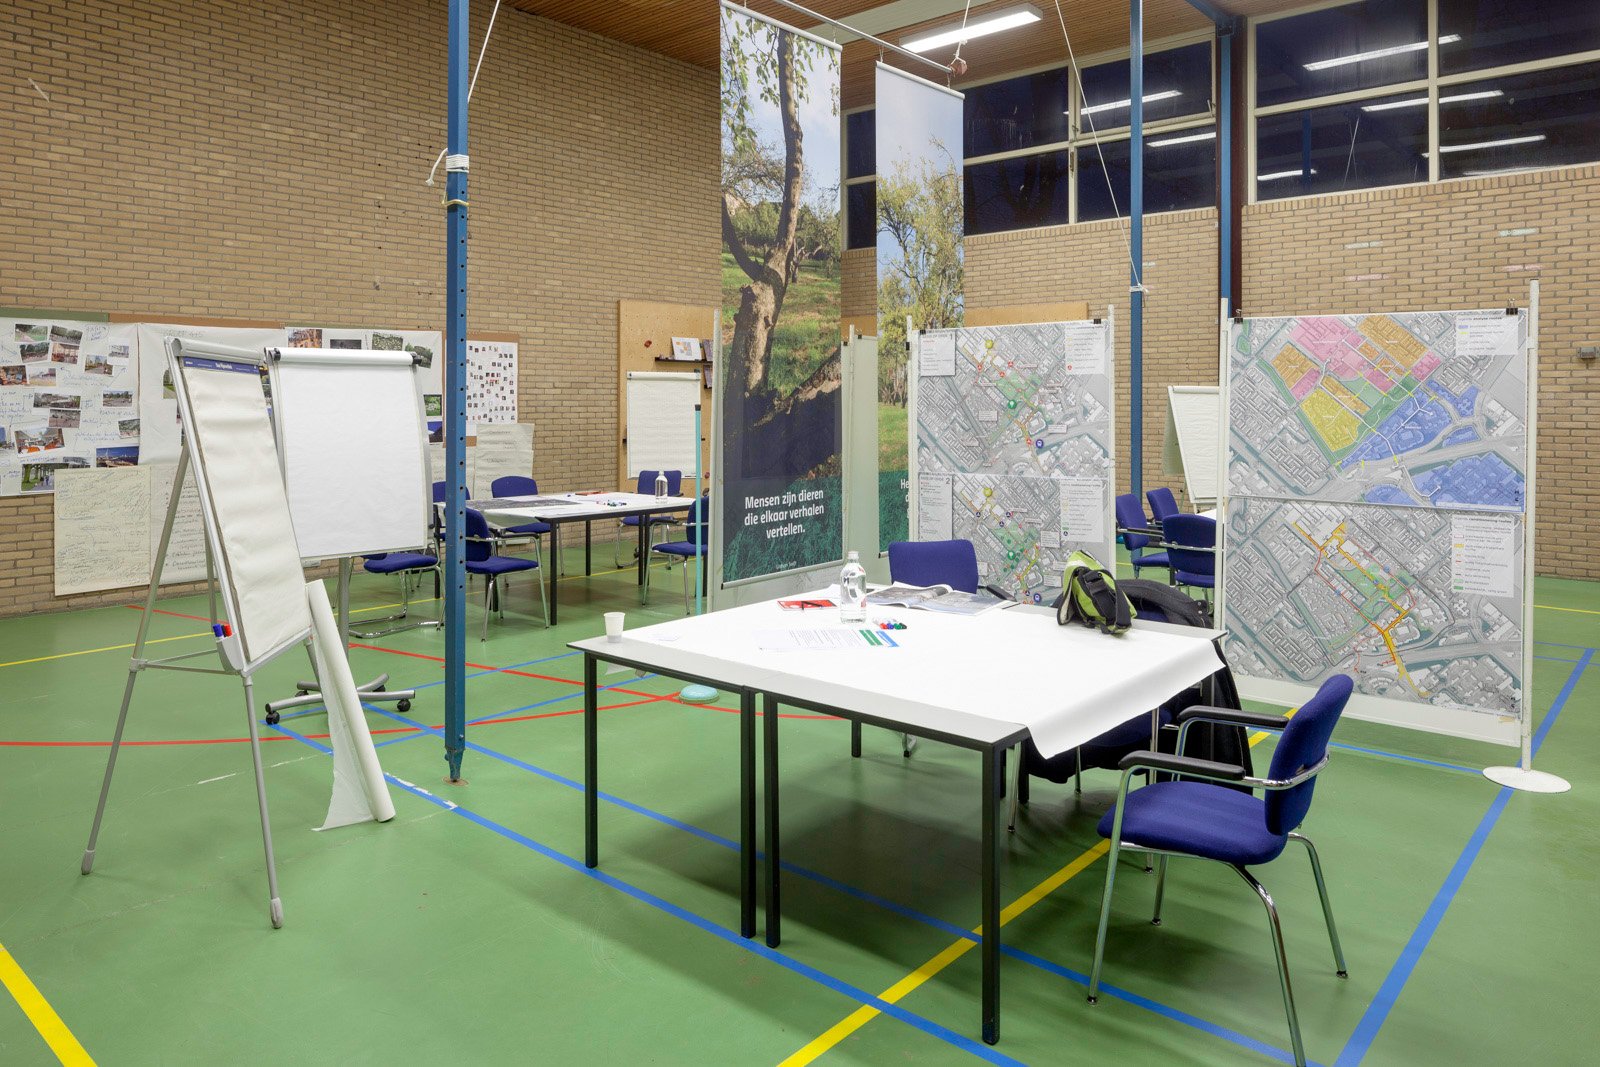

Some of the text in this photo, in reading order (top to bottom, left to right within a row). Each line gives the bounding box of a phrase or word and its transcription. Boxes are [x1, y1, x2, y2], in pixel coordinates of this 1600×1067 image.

[945, 477, 951, 485] 2
[744, 489, 824, 509] Mensen zijn dieren
[744, 503, 824, 526] die elkaar verhalen
[766, 523, 806, 539] vertellen.
